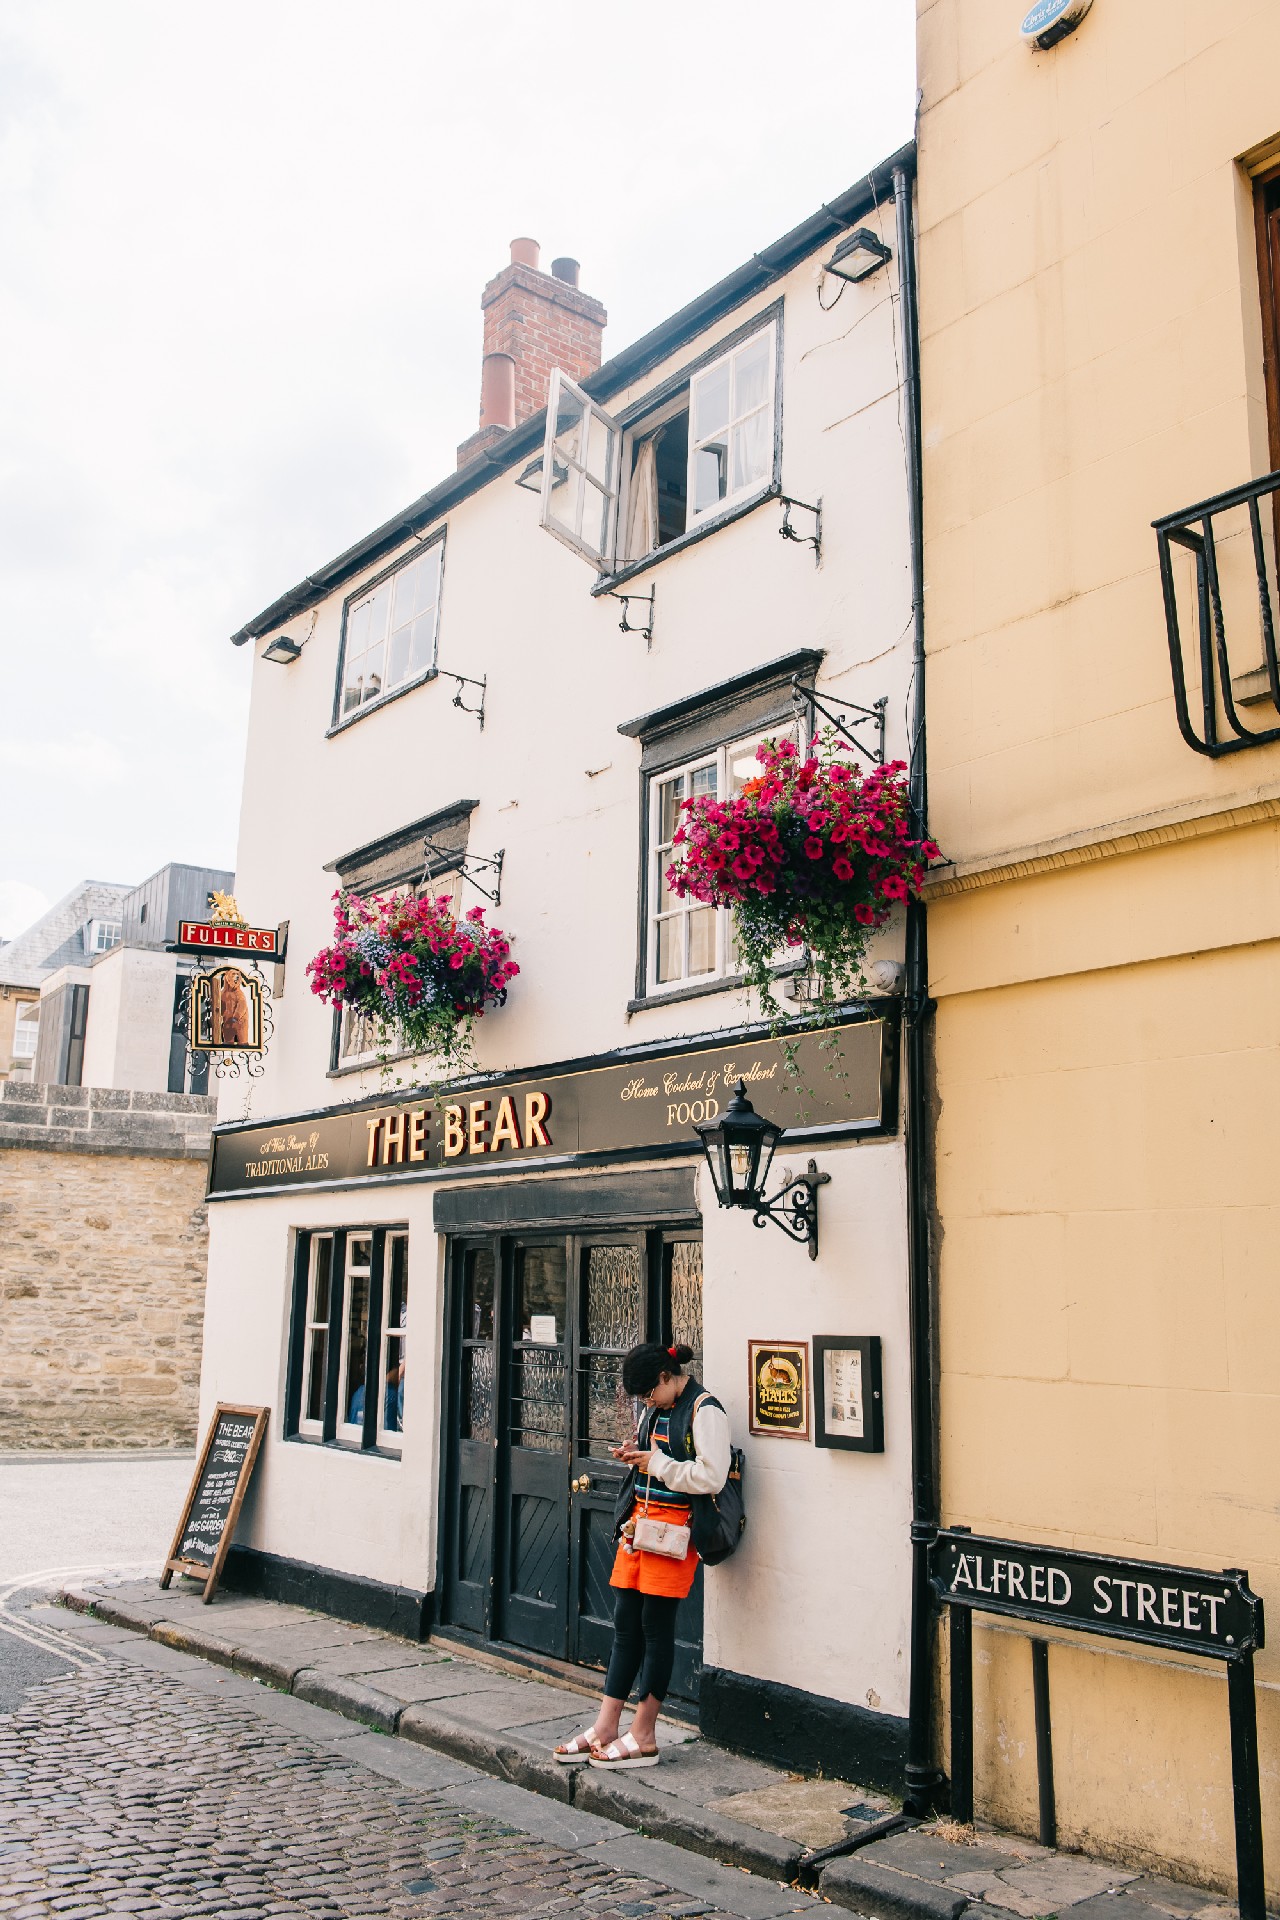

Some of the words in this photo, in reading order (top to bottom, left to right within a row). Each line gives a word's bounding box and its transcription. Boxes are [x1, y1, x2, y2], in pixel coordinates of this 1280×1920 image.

[186, 924, 271, 949] FULLER'S
[620, 1077, 659, 1101] Home
[663, 1070, 704, 1096] Cooked
[705, 1070, 720, 1097] &
[666, 1098, 719, 1126] FOOD
[366, 1110, 431, 1167] THE
[444, 1091, 553, 1157] BEAR
[245, 1157, 304, 1178] TRADITIONAL
[304, 1152, 329, 1171] ALES
[218, 1422, 234, 1437] THE
[232, 1424, 255, 1440] BEAR
[953, 1553, 1072, 1606] ALFRED
[1093, 1575, 1226, 1635] STREET
